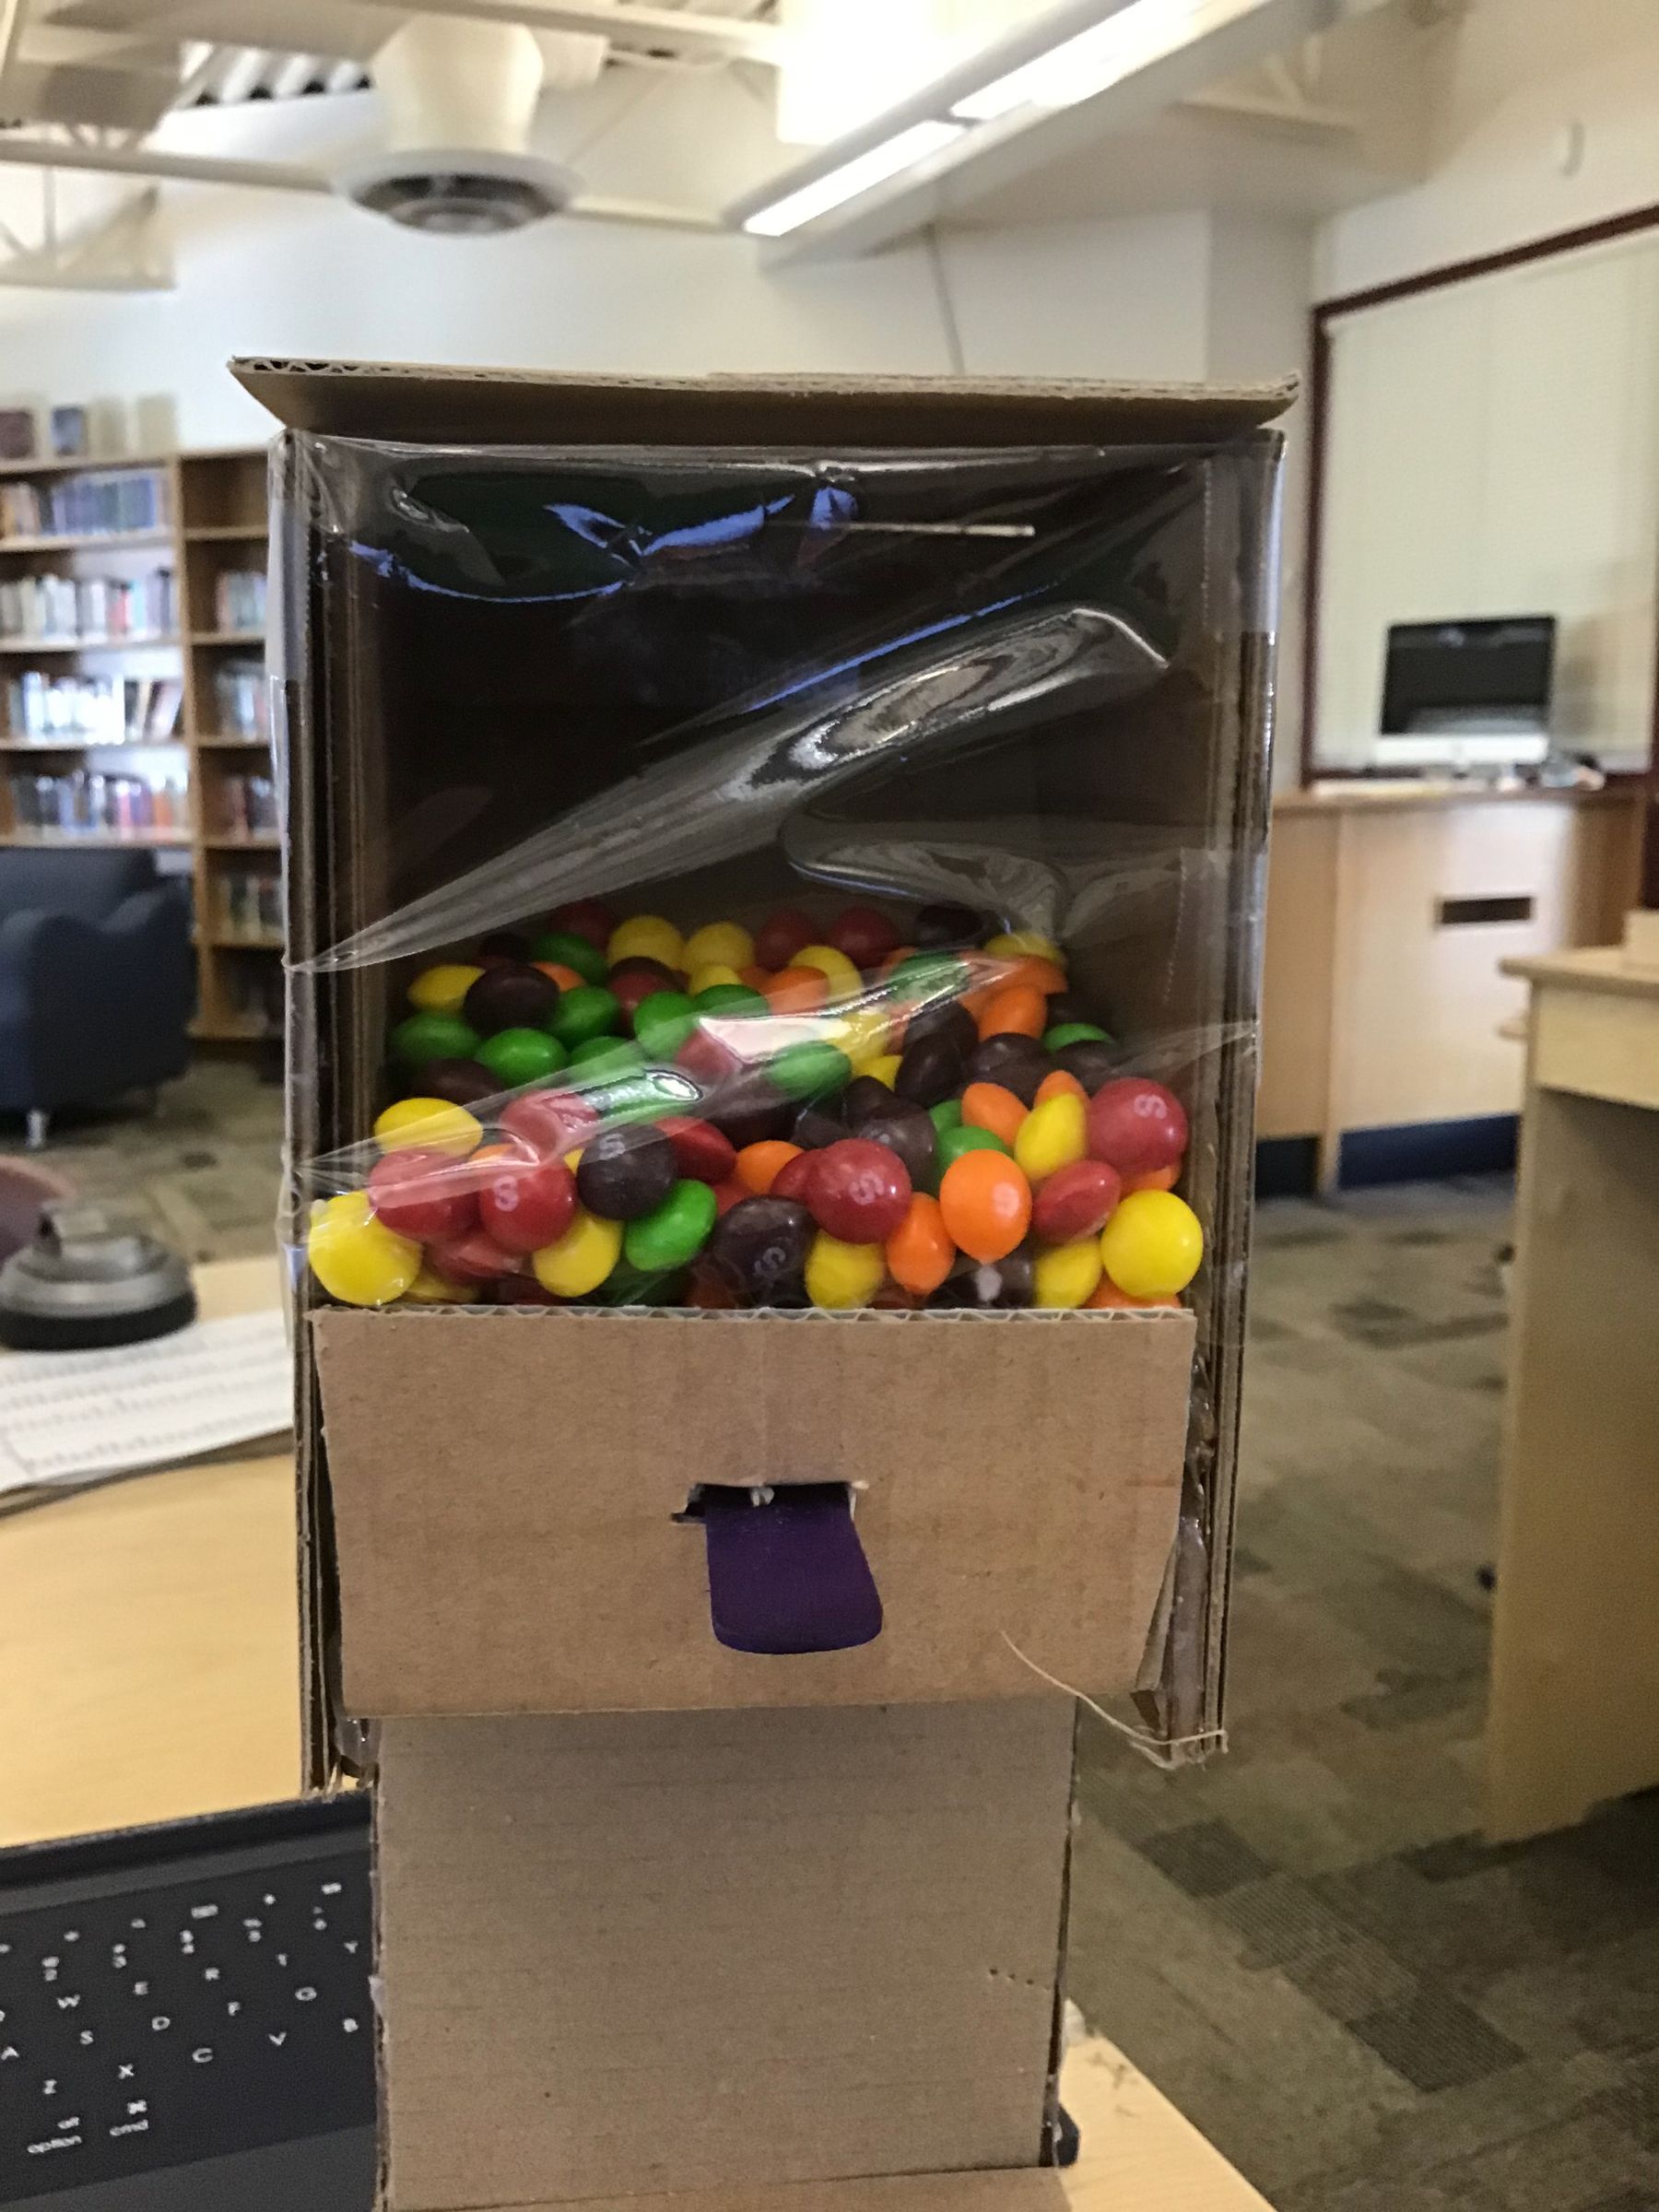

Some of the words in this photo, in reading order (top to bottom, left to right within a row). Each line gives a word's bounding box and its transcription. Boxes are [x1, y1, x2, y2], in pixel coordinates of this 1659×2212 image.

[80, 2030, 93, 2045] S
[192, 2047, 213, 2063] C
[118, 2064, 135, 2079] X
